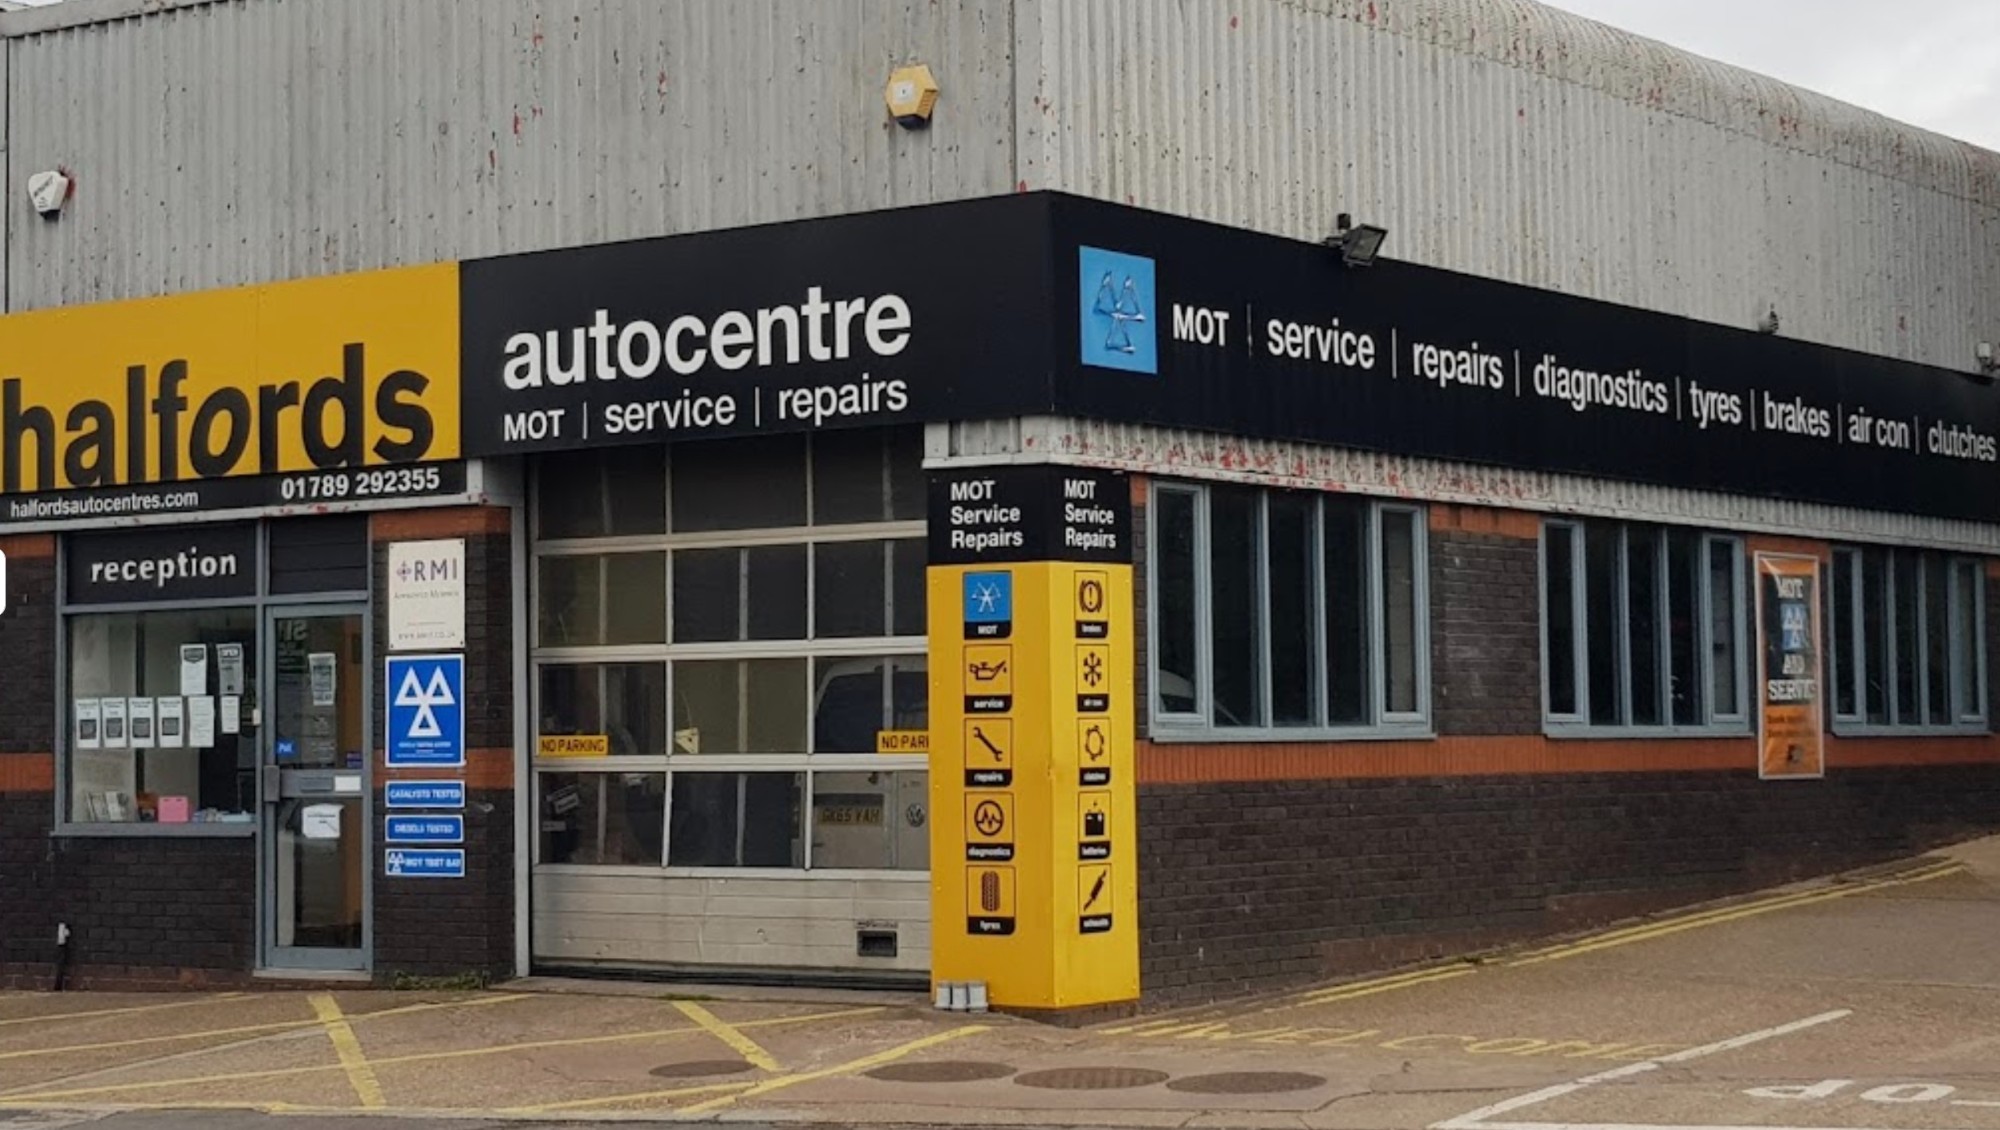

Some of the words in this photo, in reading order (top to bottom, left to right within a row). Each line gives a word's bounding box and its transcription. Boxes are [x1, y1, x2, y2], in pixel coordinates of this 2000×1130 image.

[504, 286, 911, 390] autocentre
[1173, 304, 1229, 346] MOT
[1267, 317, 1375, 370] service
[1413, 342, 1503, 389] repairs
[1533, 354, 1668, 413] diagnostics
[1690, 380, 1742, 429] tyres
[1764, 390, 1831, 437] brakes
[1848, 406, 1873, 443] air
[1876, 418, 1909, 449] con
[1928, 419, 1996, 461] clutches
[3, 343, 434, 493] halfords
[504, 409, 565, 441] MOT
[604, 389, 736, 434] service
[779, 373, 908, 427] repairs
[281, 474, 349, 499] 01789
[355, 467, 440, 494] 292355
[951, 480, 995, 501] MOT
[1064, 478, 1096, 499] MOT
[11, 491, 199, 518] halfordsautocentres.com
[951, 504, 1021, 525] Service
[1065, 503, 1115, 525] Service
[952, 528, 1023, 552] Repairs
[1065, 527, 1116, 550] Repairs
[91, 546, 236, 587] reception
[414, 557, 458, 581] RMI
[541, 739, 556, 752] NO
[558, 738, 605, 752] PARKING
[882, 735, 898, 748] NO
